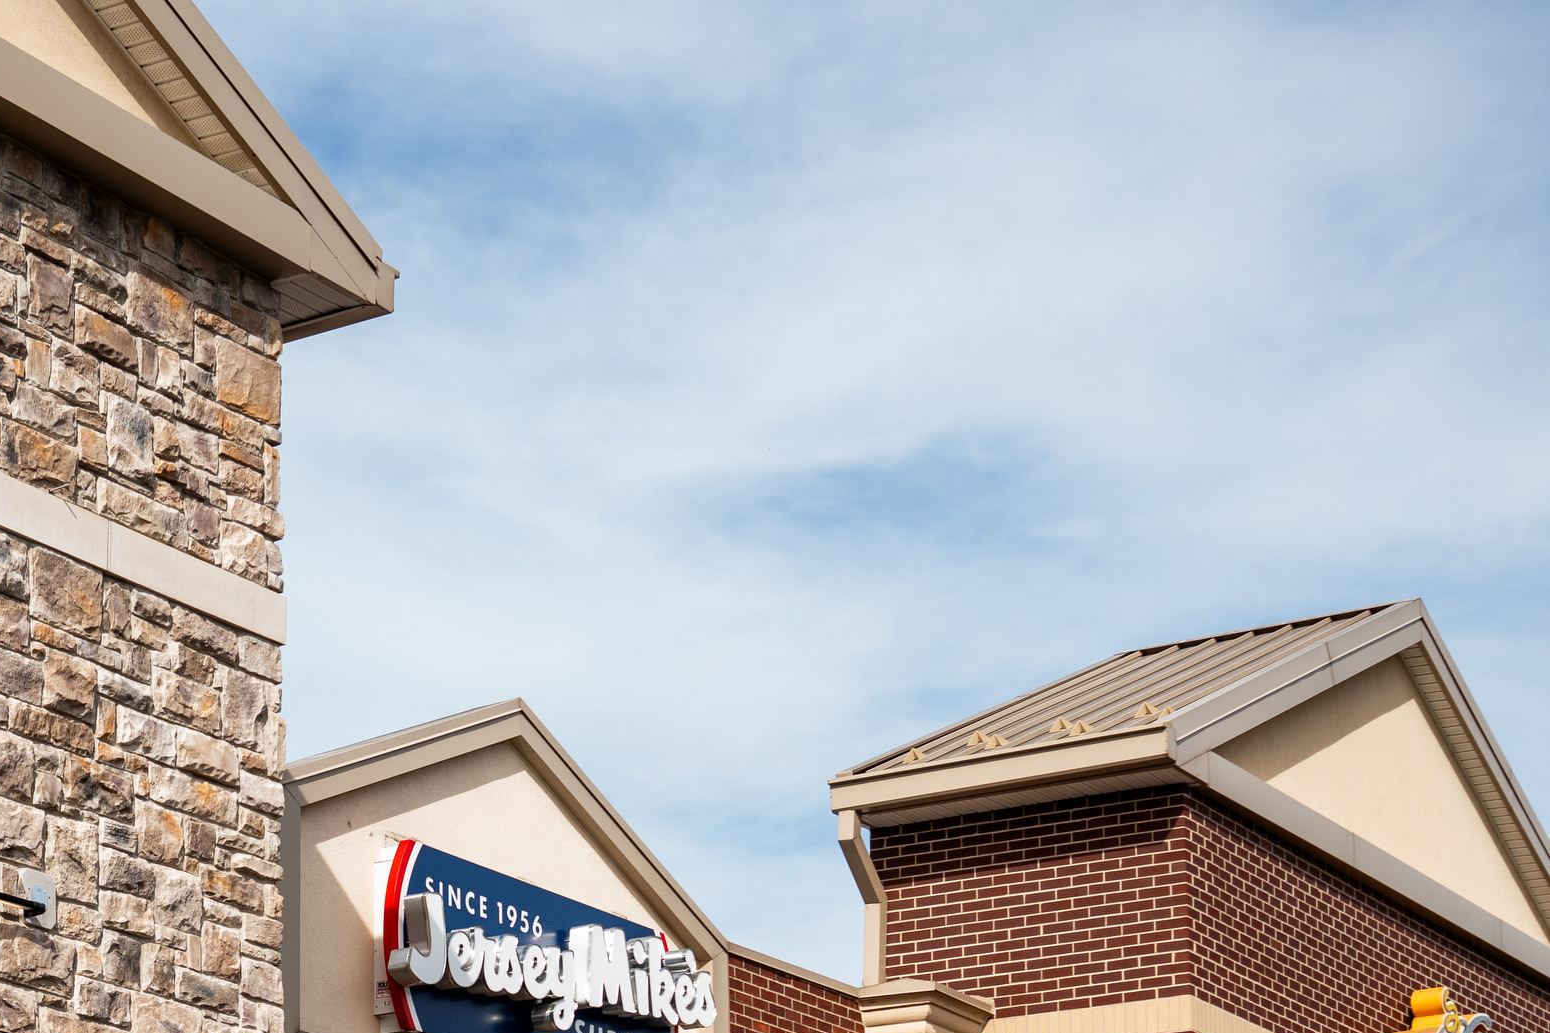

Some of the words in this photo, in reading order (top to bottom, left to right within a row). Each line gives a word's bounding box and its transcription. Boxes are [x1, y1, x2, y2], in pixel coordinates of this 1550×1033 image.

[425, 876, 488, 919] SINCE
[497, 902, 543, 938] 1956
[388, 892, 578, 1031] Jersey
[569, 923, 717, 1029] Mike's
